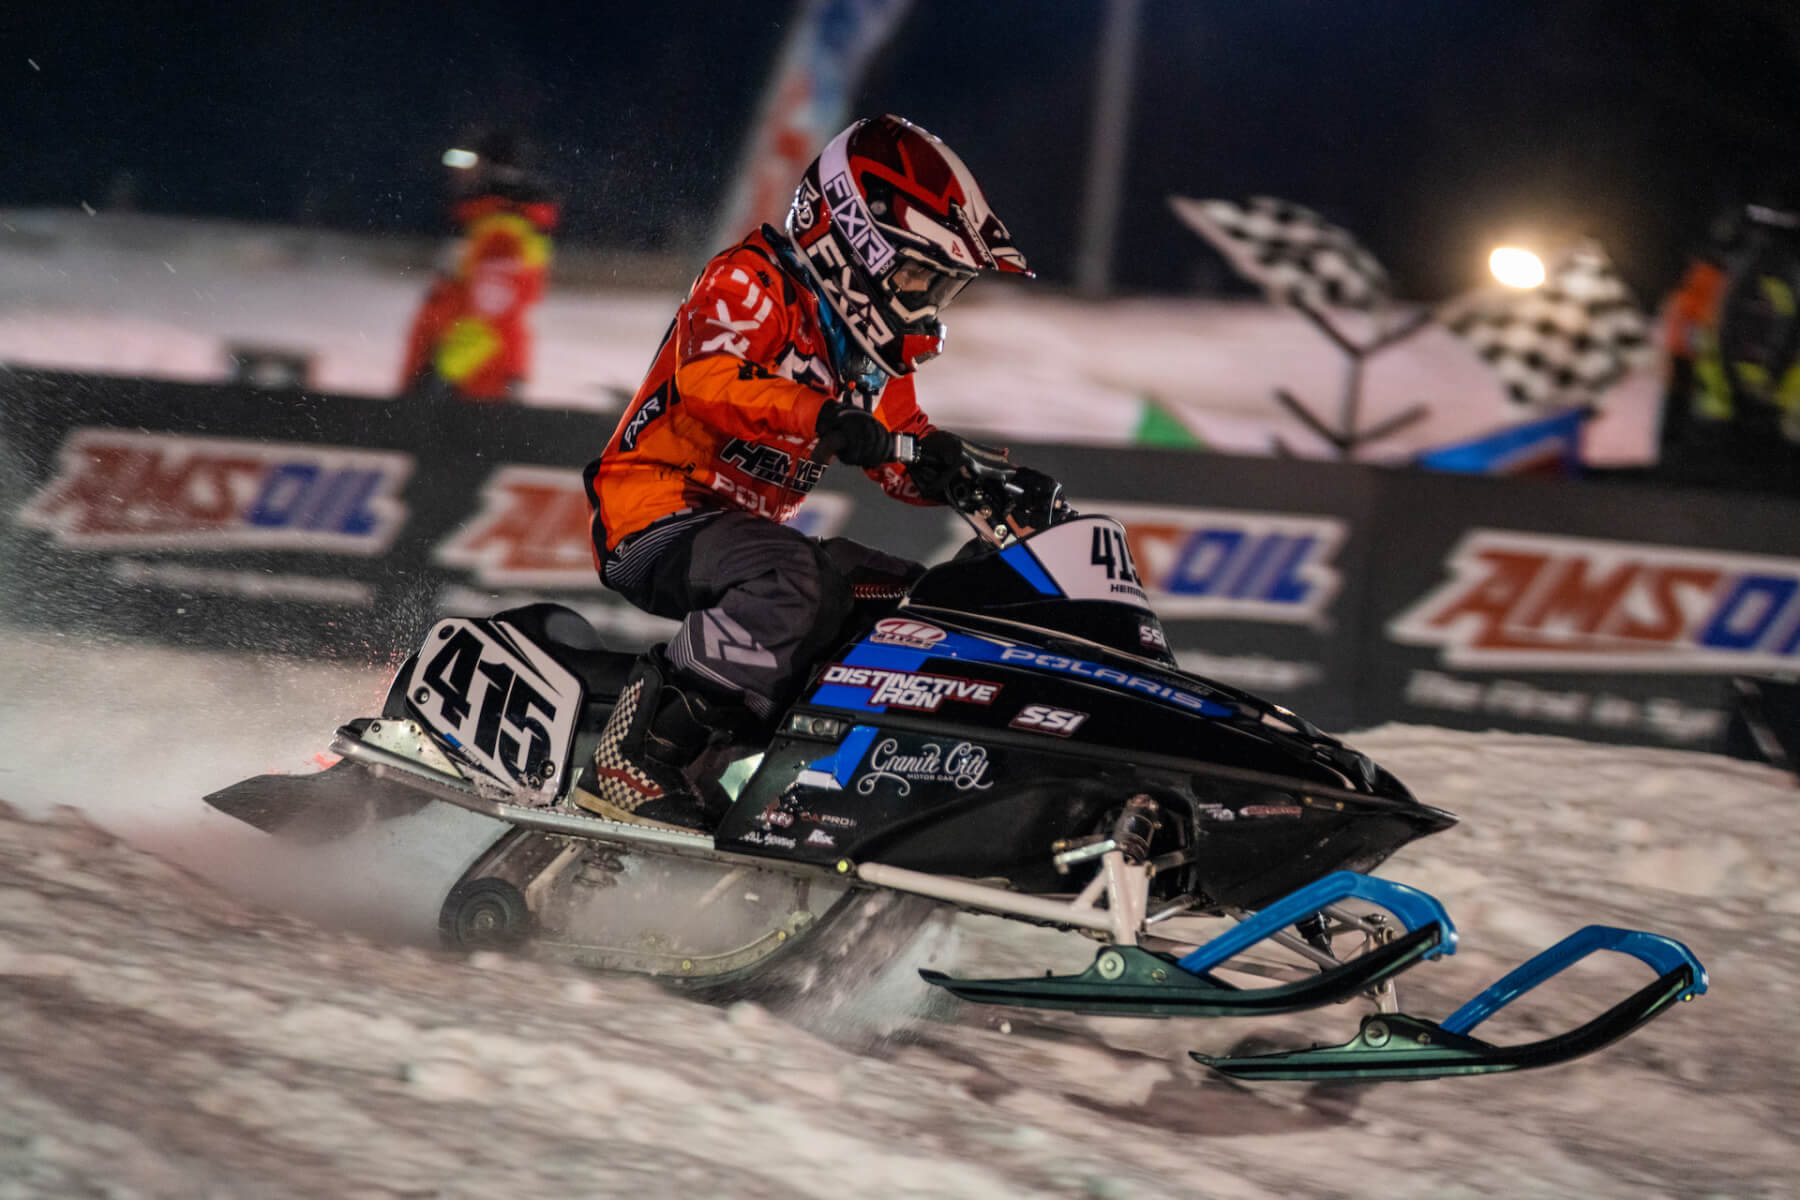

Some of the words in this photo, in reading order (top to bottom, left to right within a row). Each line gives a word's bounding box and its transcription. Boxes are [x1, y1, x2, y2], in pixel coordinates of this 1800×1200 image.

[823, 171, 892, 269] FXR
[806, 233, 896, 347] FXR
[422, 626, 557, 787] 415
[823, 665, 999, 701] DISTINCTIVE
[872, 677, 942, 708] IRON
[1000, 647, 1204, 709] POLARIS
[1017, 705, 1085, 732] SSI
[857, 738, 941, 797] Granite
[944, 742, 995, 790] City
[906, 773, 936, 782] MOTOR
[937, 774, 955, 783] CAR
